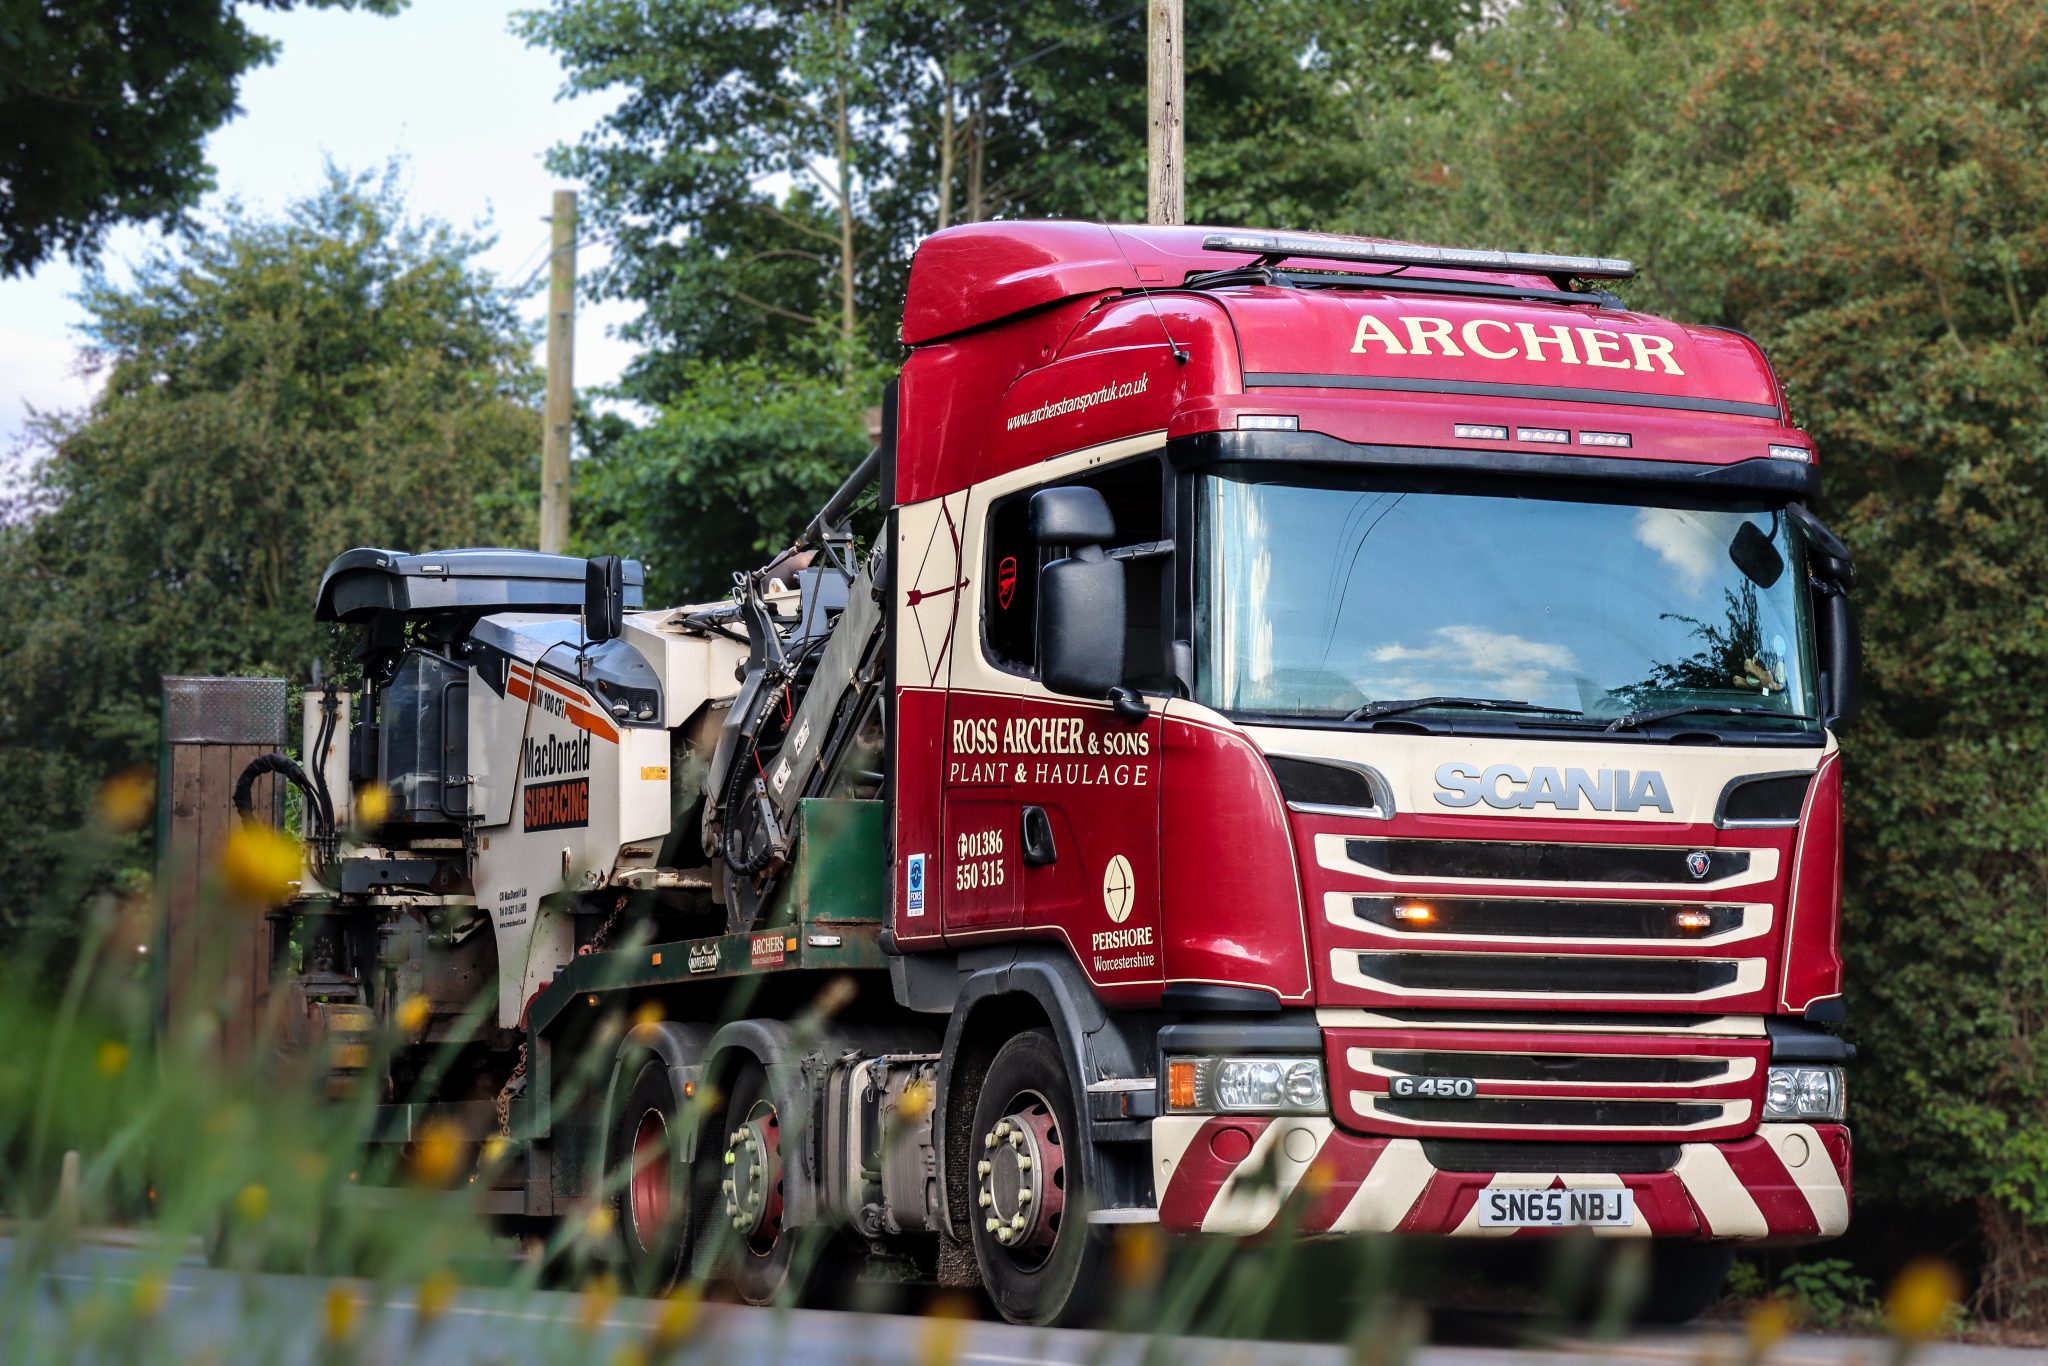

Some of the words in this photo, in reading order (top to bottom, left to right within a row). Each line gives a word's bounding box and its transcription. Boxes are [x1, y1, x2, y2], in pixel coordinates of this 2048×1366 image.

[1350, 315, 1685, 376] ARCHER
[1007, 372, 1149, 431] www.archerstransportuk.co.uk
[537, 689, 544, 707] W
[544, 691, 554, 713] 100
[953, 718, 998, 755] ROSS
[1003, 717, 1085, 754] ARCHER
[1088, 734, 1101, 755] &
[1103, 732, 1150, 756] SONS
[524, 728, 591, 779] MacDonald
[949, 763, 1009, 782] PLANT
[1014, 763, 1028, 783] &
[1035, 763, 1149, 786] HAULAGE
[1433, 762, 1674, 813] SCANIA
[525, 781, 588, 828] SURFACING
[969, 829, 1003, 858] 01386
[957, 863, 978, 890] 550
[982, 859, 1004, 887] 315
[910, 891, 922, 901] FORS
[752, 936, 784, 955] ARCHERS
[1092, 927, 1153, 951] PERSHORE
[1093, 951, 1155, 972] Worcestershire
[1395, 1078, 1413, 1096] G
[1418, 1078, 1473, 1097] 450
[1491, 1193, 1562, 1222] SN65
[1571, 1193, 1622, 1222] NBJ
